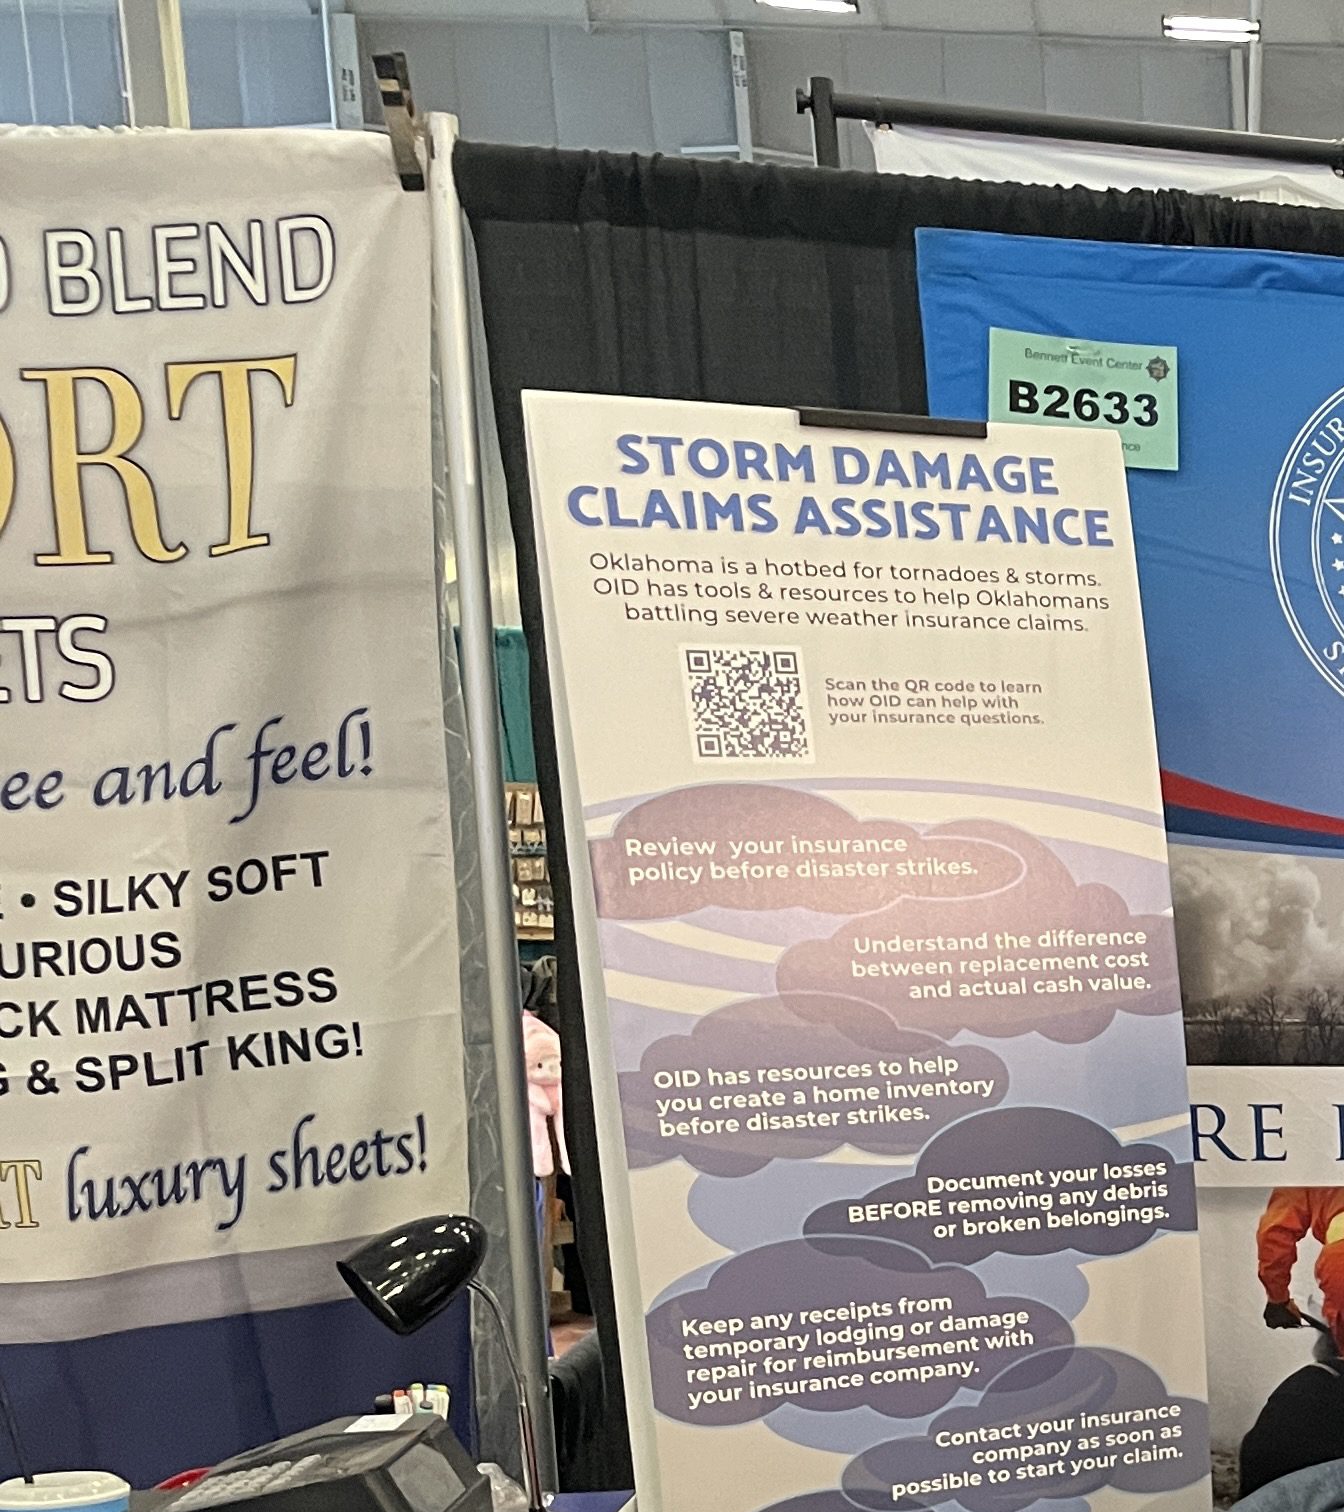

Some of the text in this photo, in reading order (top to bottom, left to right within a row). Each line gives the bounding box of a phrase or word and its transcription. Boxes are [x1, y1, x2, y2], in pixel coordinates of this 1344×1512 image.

[43, 215, 336, 317] BLEND
[1025, 348, 1142, 371] Bennett Event Center
[1009, 379, 1158, 427] B2633
[0, 353, 298, 567] RT
[616, 433, 1059, 496] STORM DAMAGE
[567, 485, 1114, 548] CLAIMS ASSISTANCE
[589, 552, 1102, 587] Oklahoma is a hotbed for tornadoes & storms.
[593, 577, 1110, 610] OID has tools & resources to help Oklahomans
[0, 614, 116, 704] TS
[825, 677, 1042, 694] Scan the QR code to learn
[92, 722, 236, 808] and
[228, 707, 374, 824] feel!
[53, 851, 330, 919] SILKY SOFT
[76, 967, 338, 1035] MATTRESS
[27, 1058, 60, 1095] &
[75, 1040, 210, 1093] SPLIT
[228, 1021, 364, 1071] KING!
[66, 1145, 248, 1232] luxury
[267, 1113, 428, 1193] sheets!
[848, 1182, 1169, 1223] BEFORE removing any debris
[927, 1162, 1167, 1194] Document your losses
